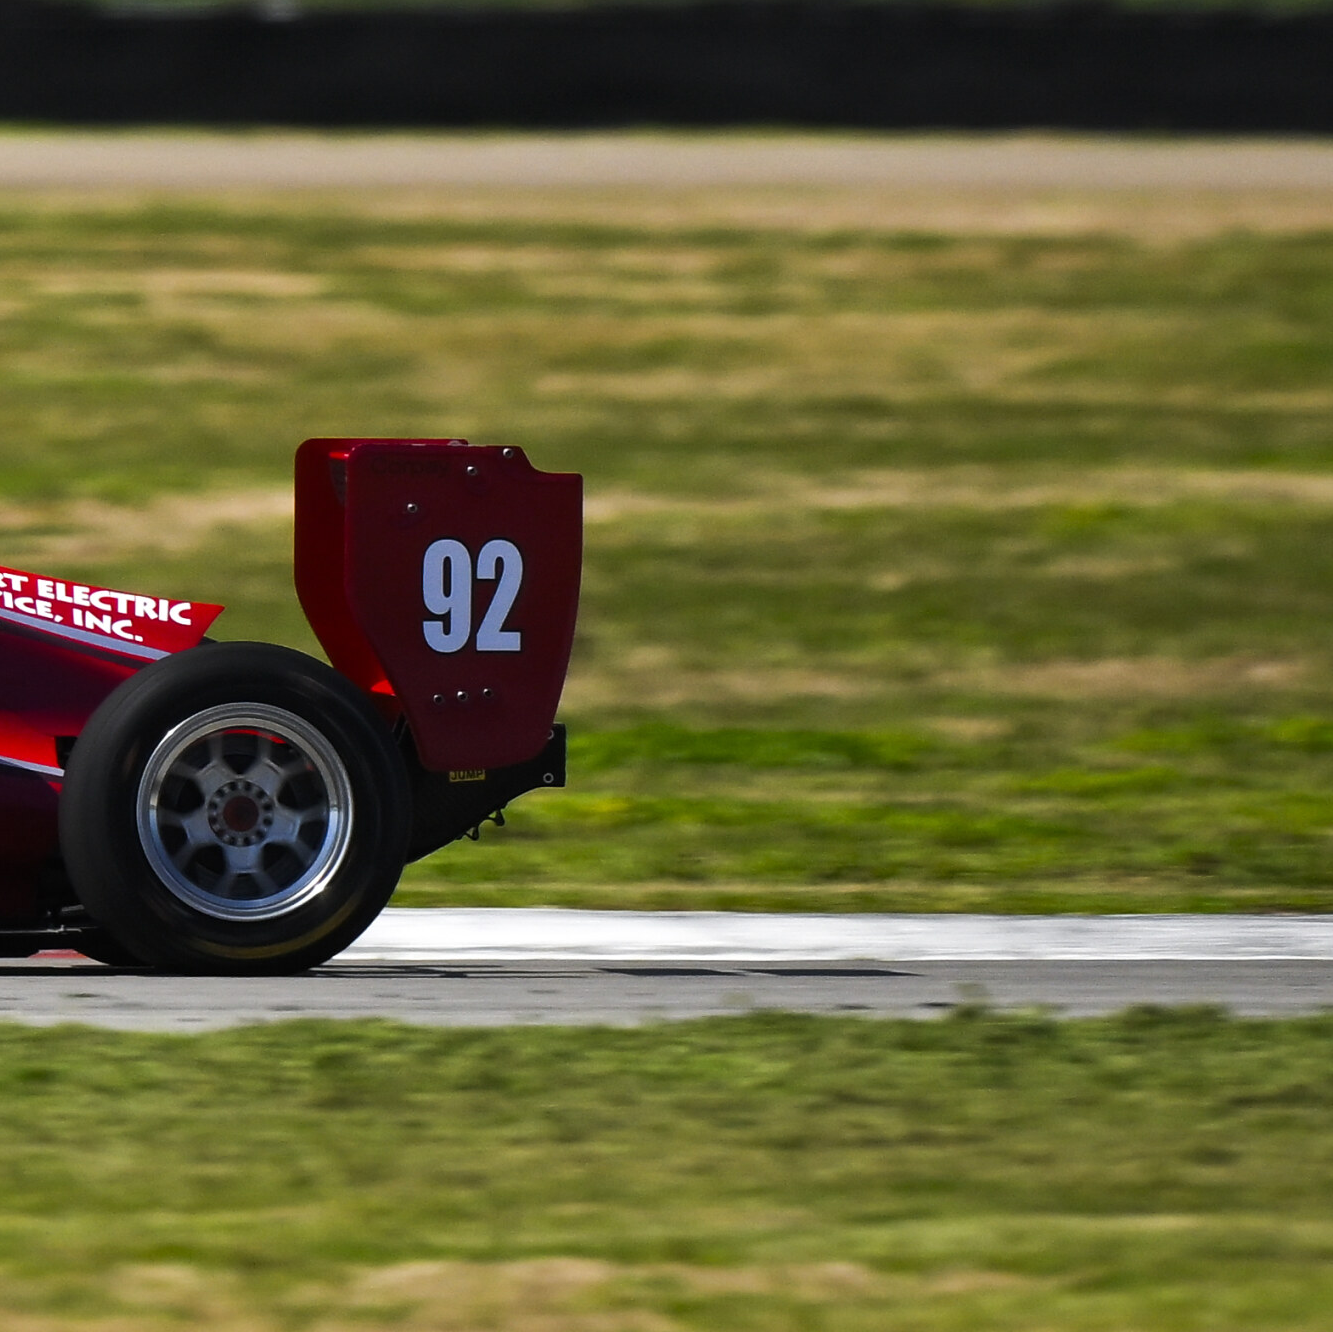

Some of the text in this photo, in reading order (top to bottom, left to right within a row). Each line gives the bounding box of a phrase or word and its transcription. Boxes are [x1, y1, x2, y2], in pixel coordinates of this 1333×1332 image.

[36, 578, 191, 626] ELECTRIC
[422, 538, 524, 654] 92
[72, 608, 143, 642] INC.
[450, 769, 484, 781] JUMP
